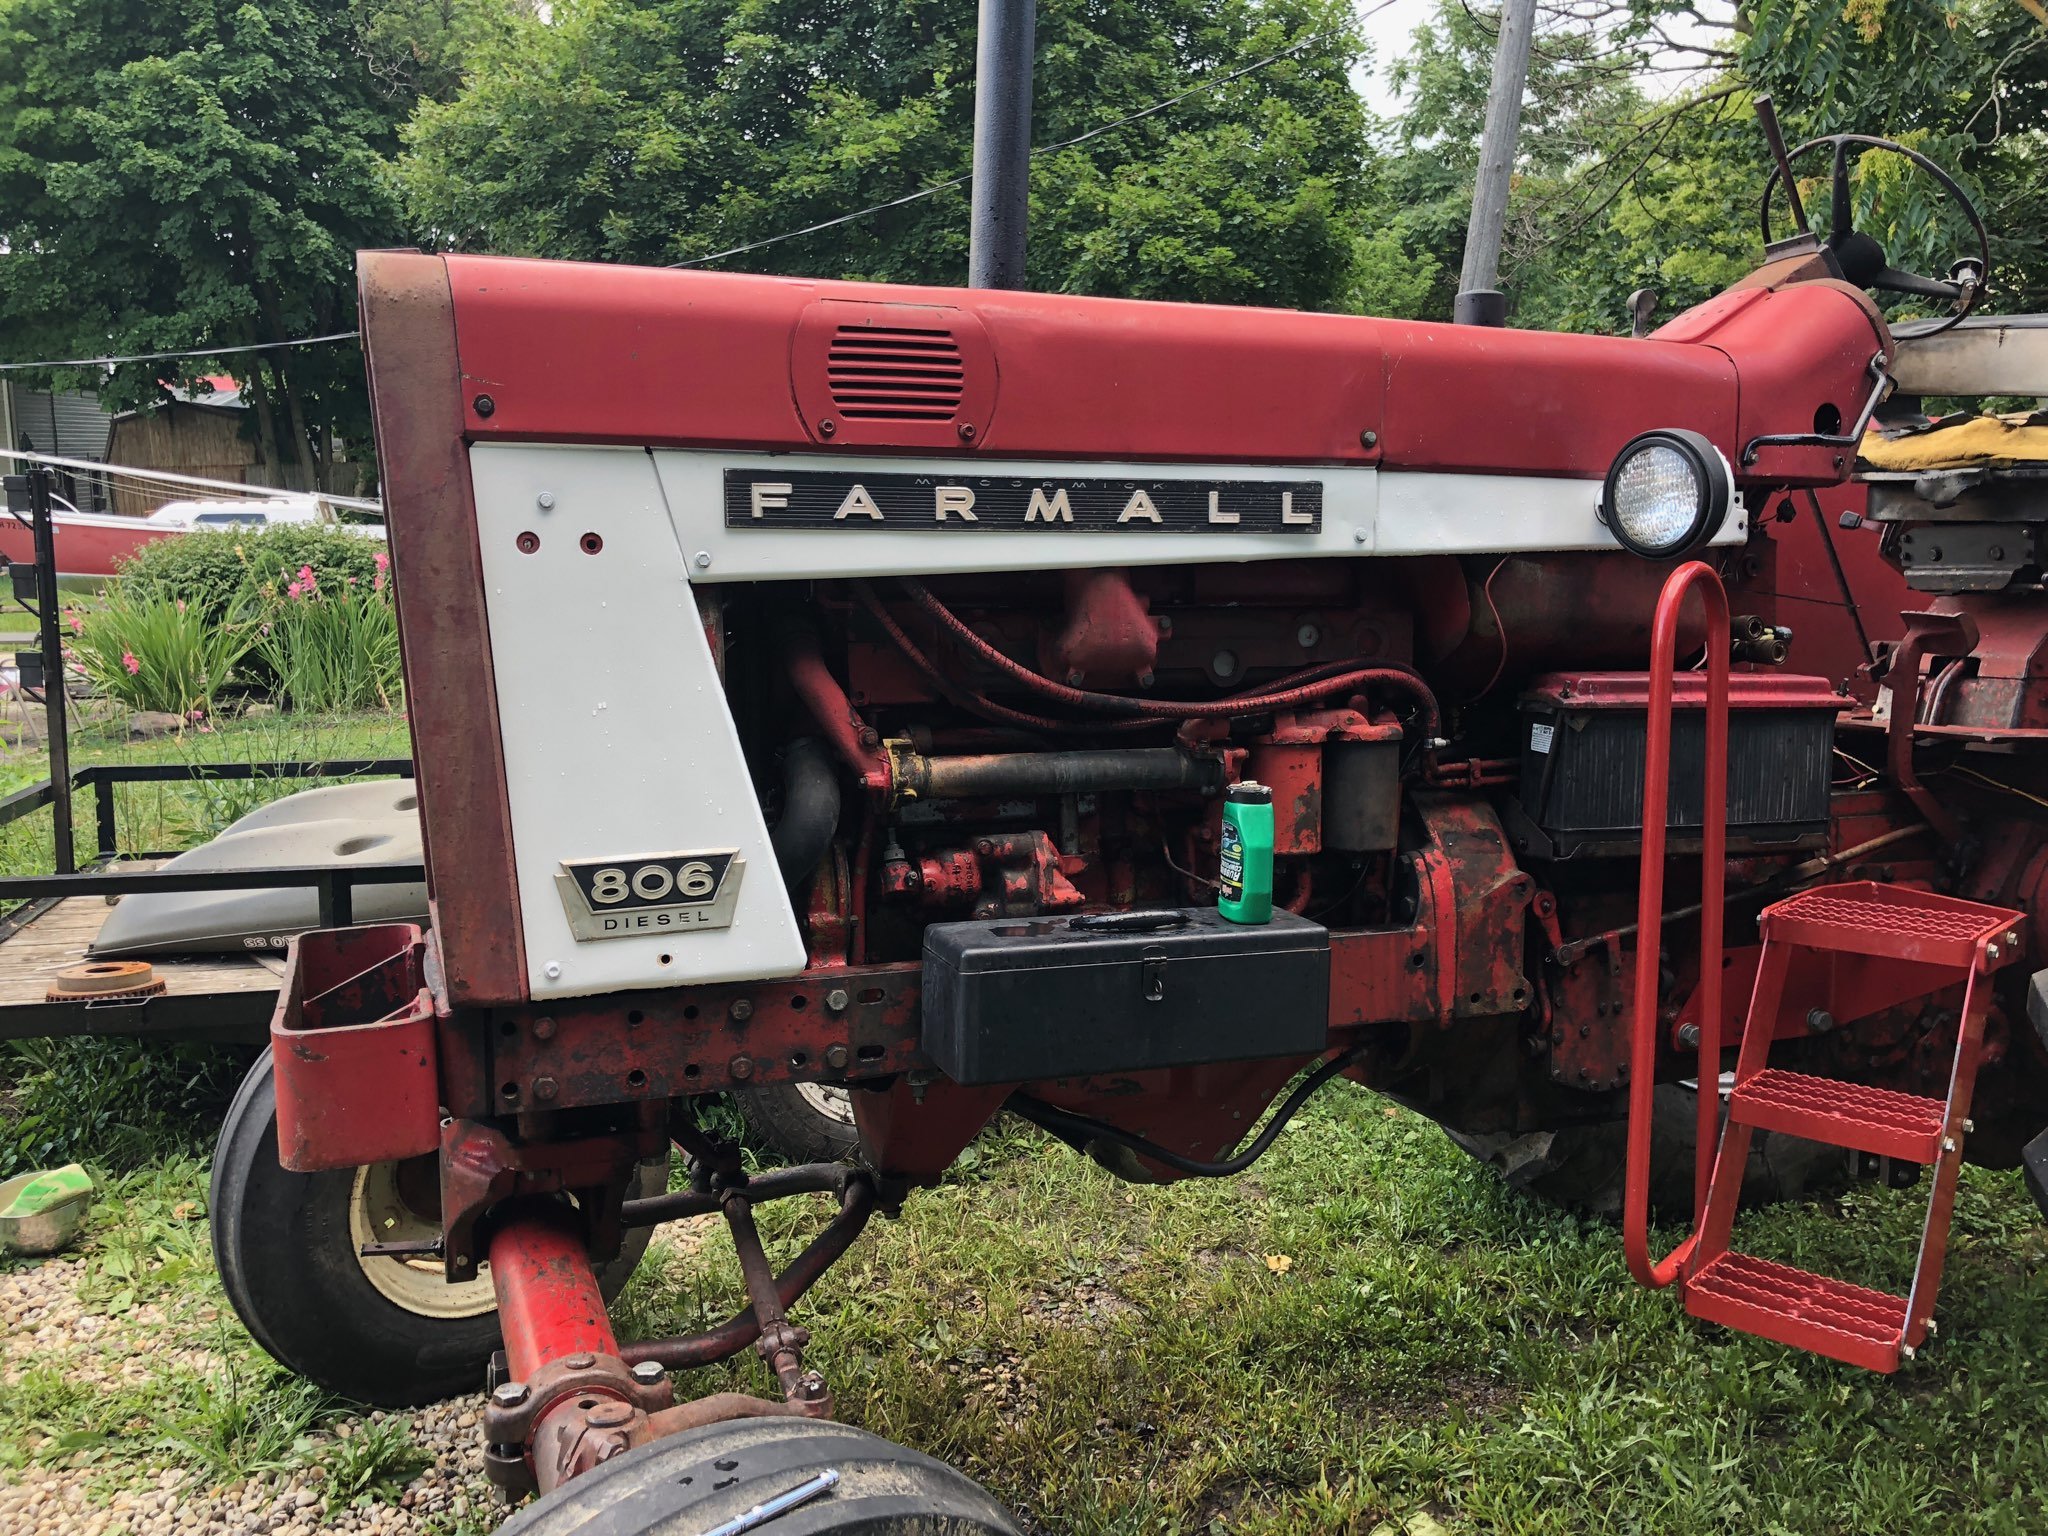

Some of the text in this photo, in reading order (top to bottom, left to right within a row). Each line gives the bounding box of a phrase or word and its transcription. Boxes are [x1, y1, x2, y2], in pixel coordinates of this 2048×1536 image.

[750, 482, 1313, 525] FARMALL
[591, 861, 714, 904] 806
[604, 911, 709, 931] DIESEL
